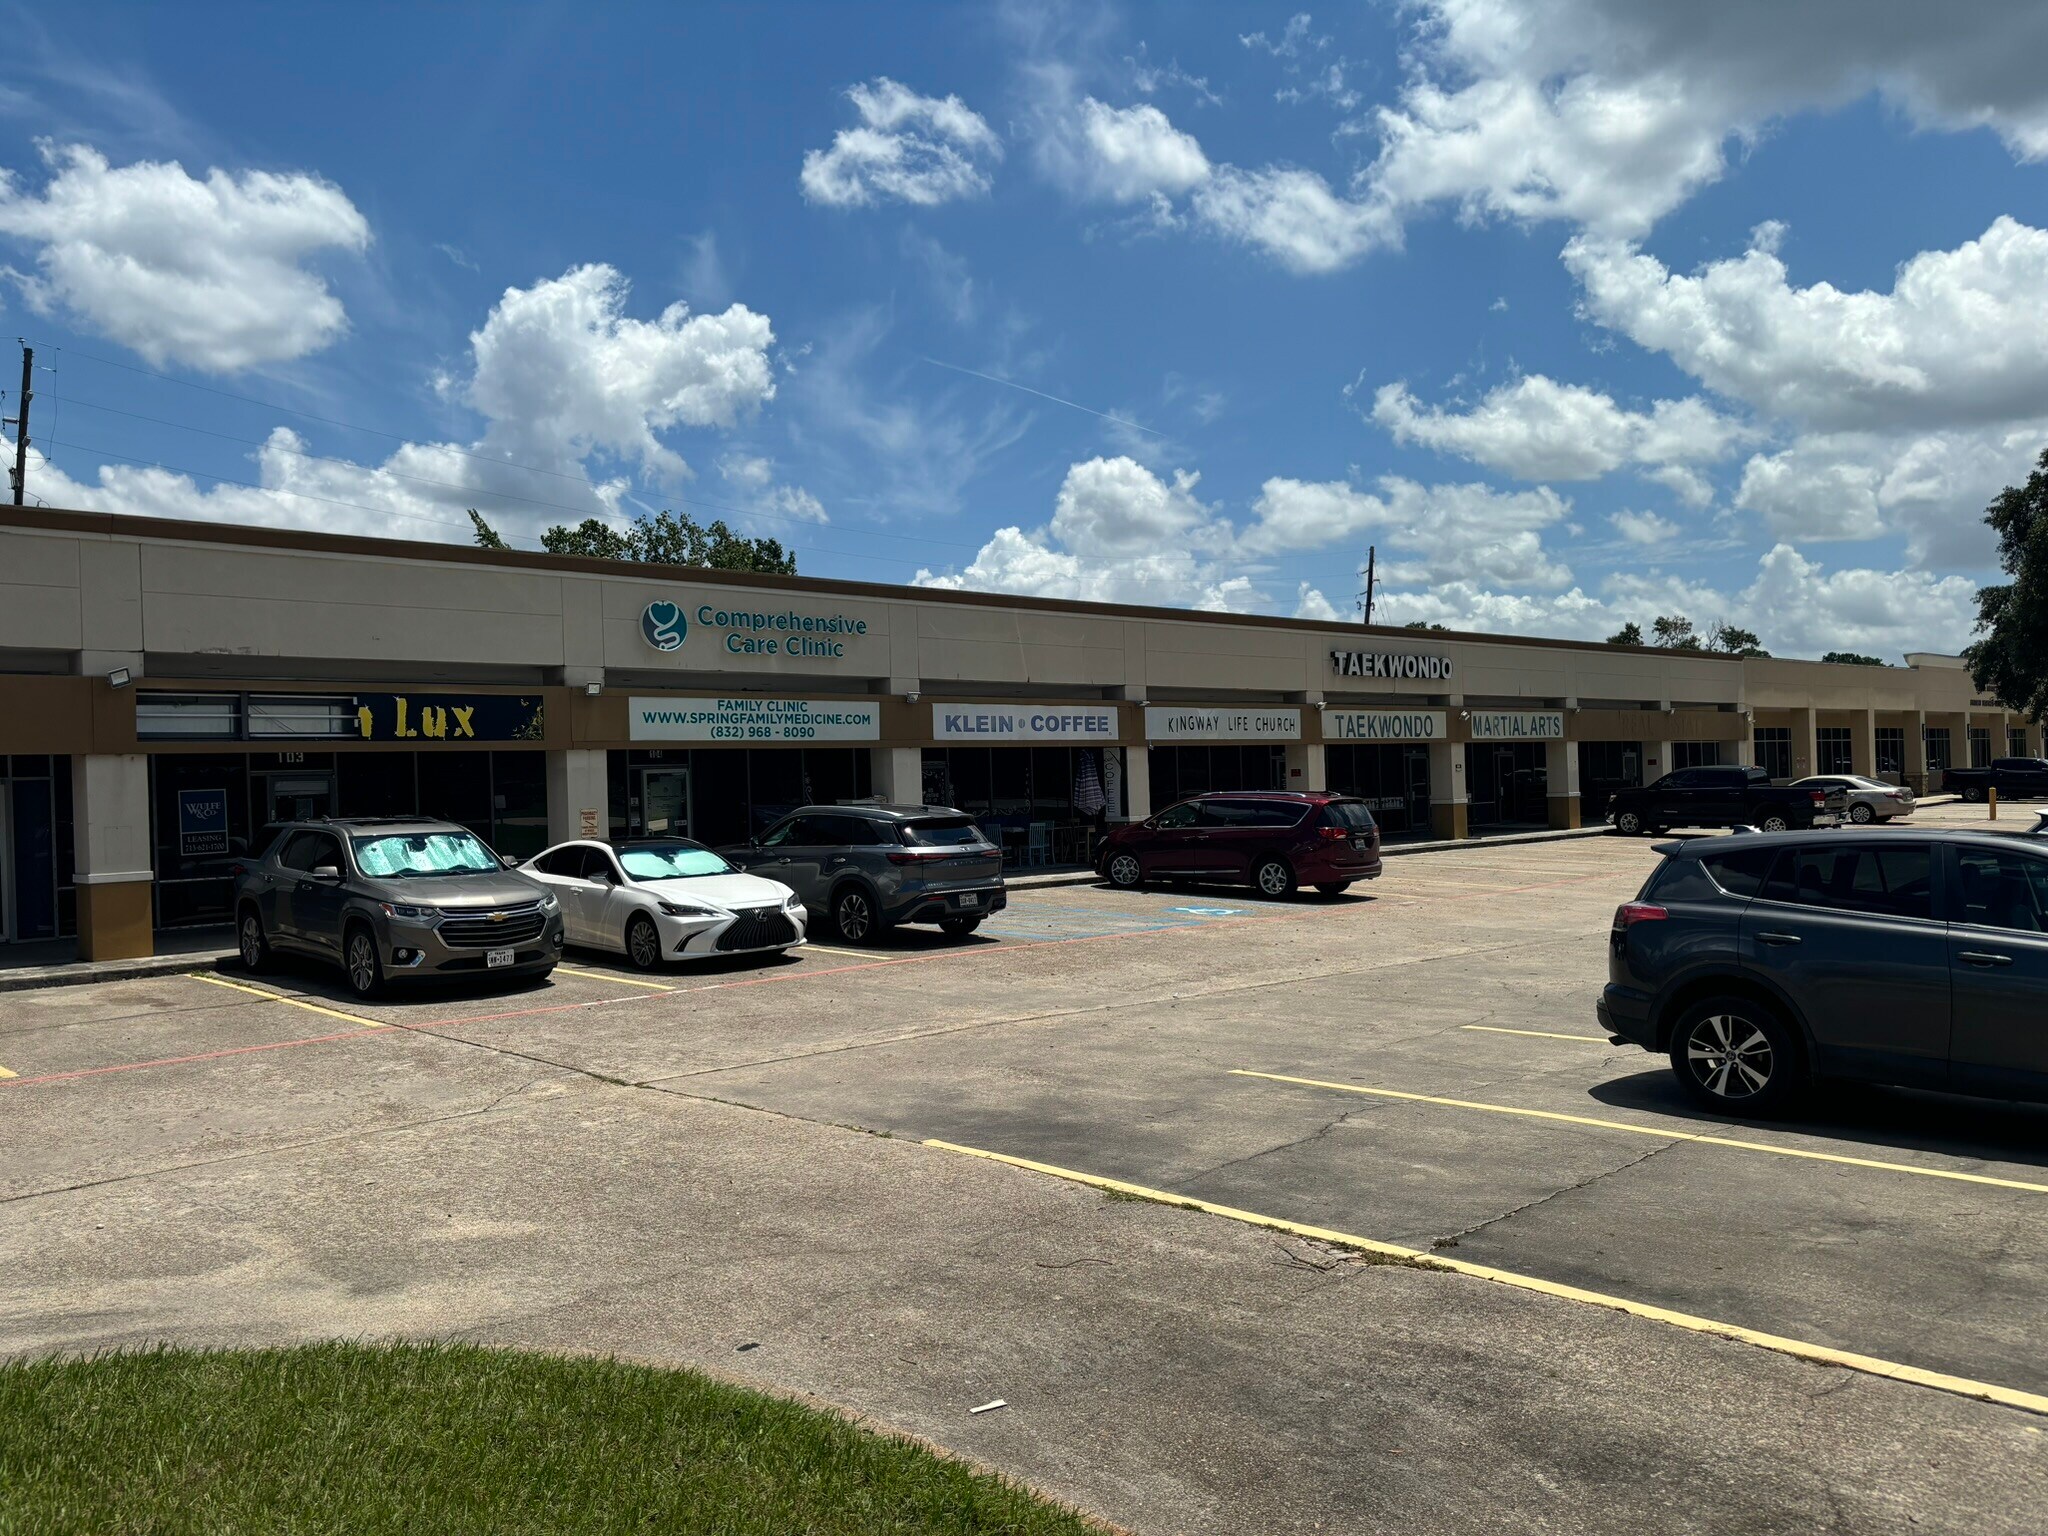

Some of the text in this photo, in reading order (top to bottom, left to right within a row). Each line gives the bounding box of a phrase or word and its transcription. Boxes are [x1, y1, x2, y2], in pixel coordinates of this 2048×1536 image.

[697, 605, 868, 636] Comprehensive
[727, 633, 844, 658] Care Clinic
[1332, 651, 1453, 680] TAEKWONDO
[717, 700, 808, 714] FAMILY CLINIC
[643, 712, 871, 726] WWW.SPRINGFAMILYMEDICINE.COM
[945, 714, 1109, 732] KLEIN COFFEE
[1168, 715, 1296, 733] KINGWAY LIFE CHURCH
[1334, 714, 1434, 738] TAEKWONDO
[1472, 715, 1561, 737] MARTIAL ARTS
[710, 726, 745, 740] (832)
[748, 726, 771, 739] 968
[783, 727, 816, 739] 8090
[278, 752, 304, 764] 103
[1105, 762, 1116, 813] COFFEE
[187, 835, 222, 843] LEASING
